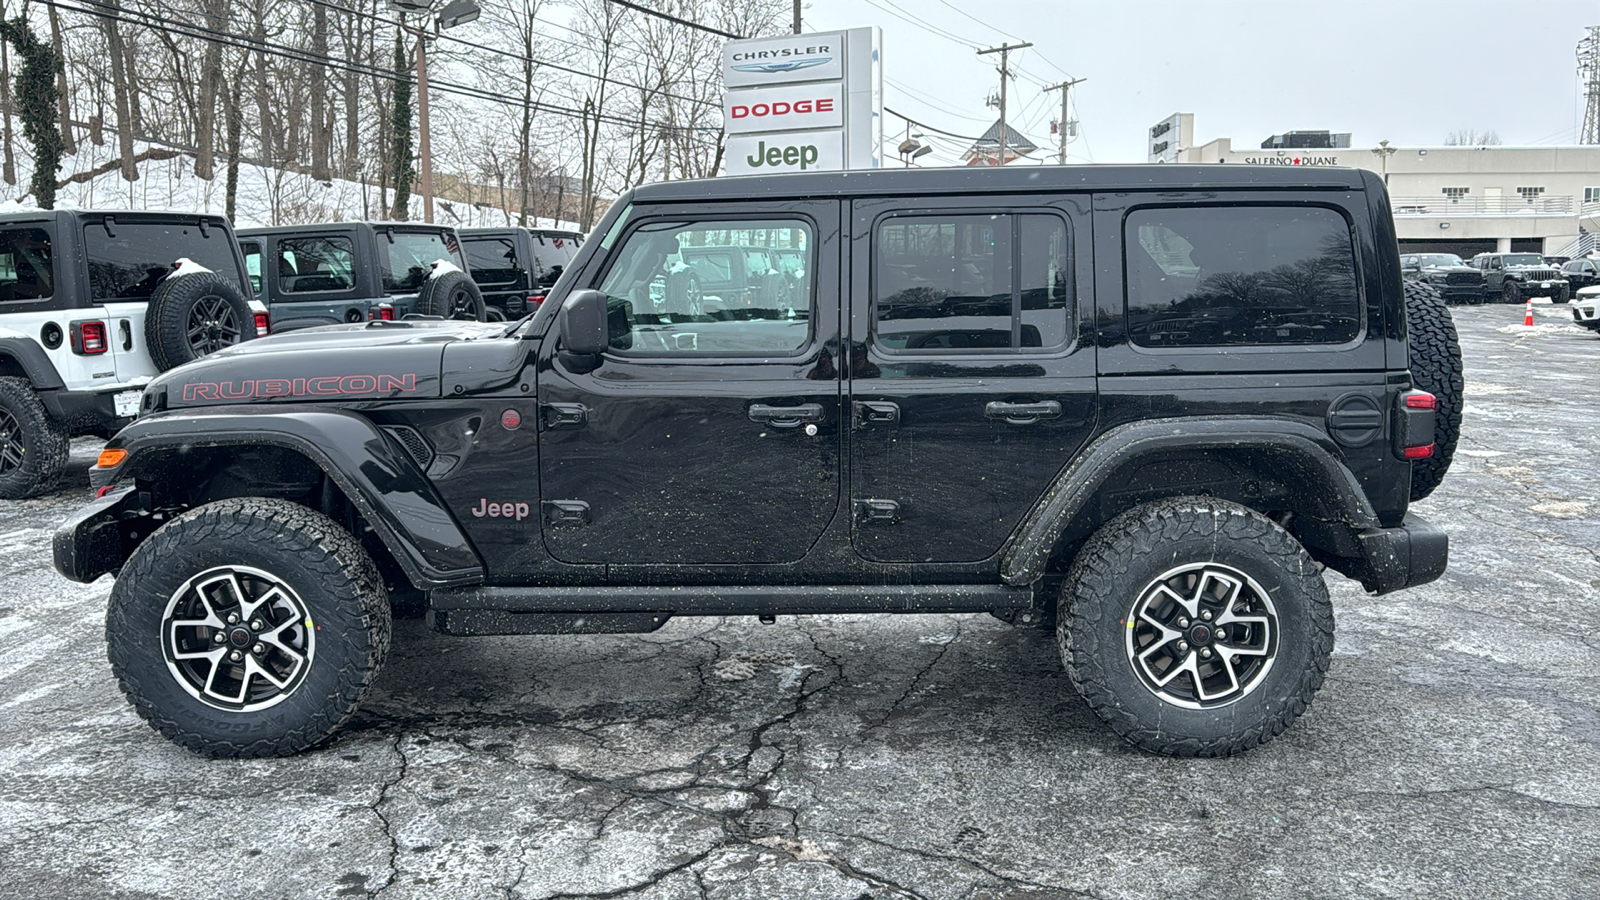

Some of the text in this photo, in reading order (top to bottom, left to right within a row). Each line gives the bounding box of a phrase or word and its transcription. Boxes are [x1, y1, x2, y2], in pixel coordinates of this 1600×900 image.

[732, 45, 830, 61] CHRYSLER
[731, 98, 834, 119] DODGE
[747, 141, 818, 170] Jeep
[1245, 156, 1338, 166] SALERNO DUANE
[182, 373, 416, 401] RUBICON
[471, 498, 530, 521] Jeep
